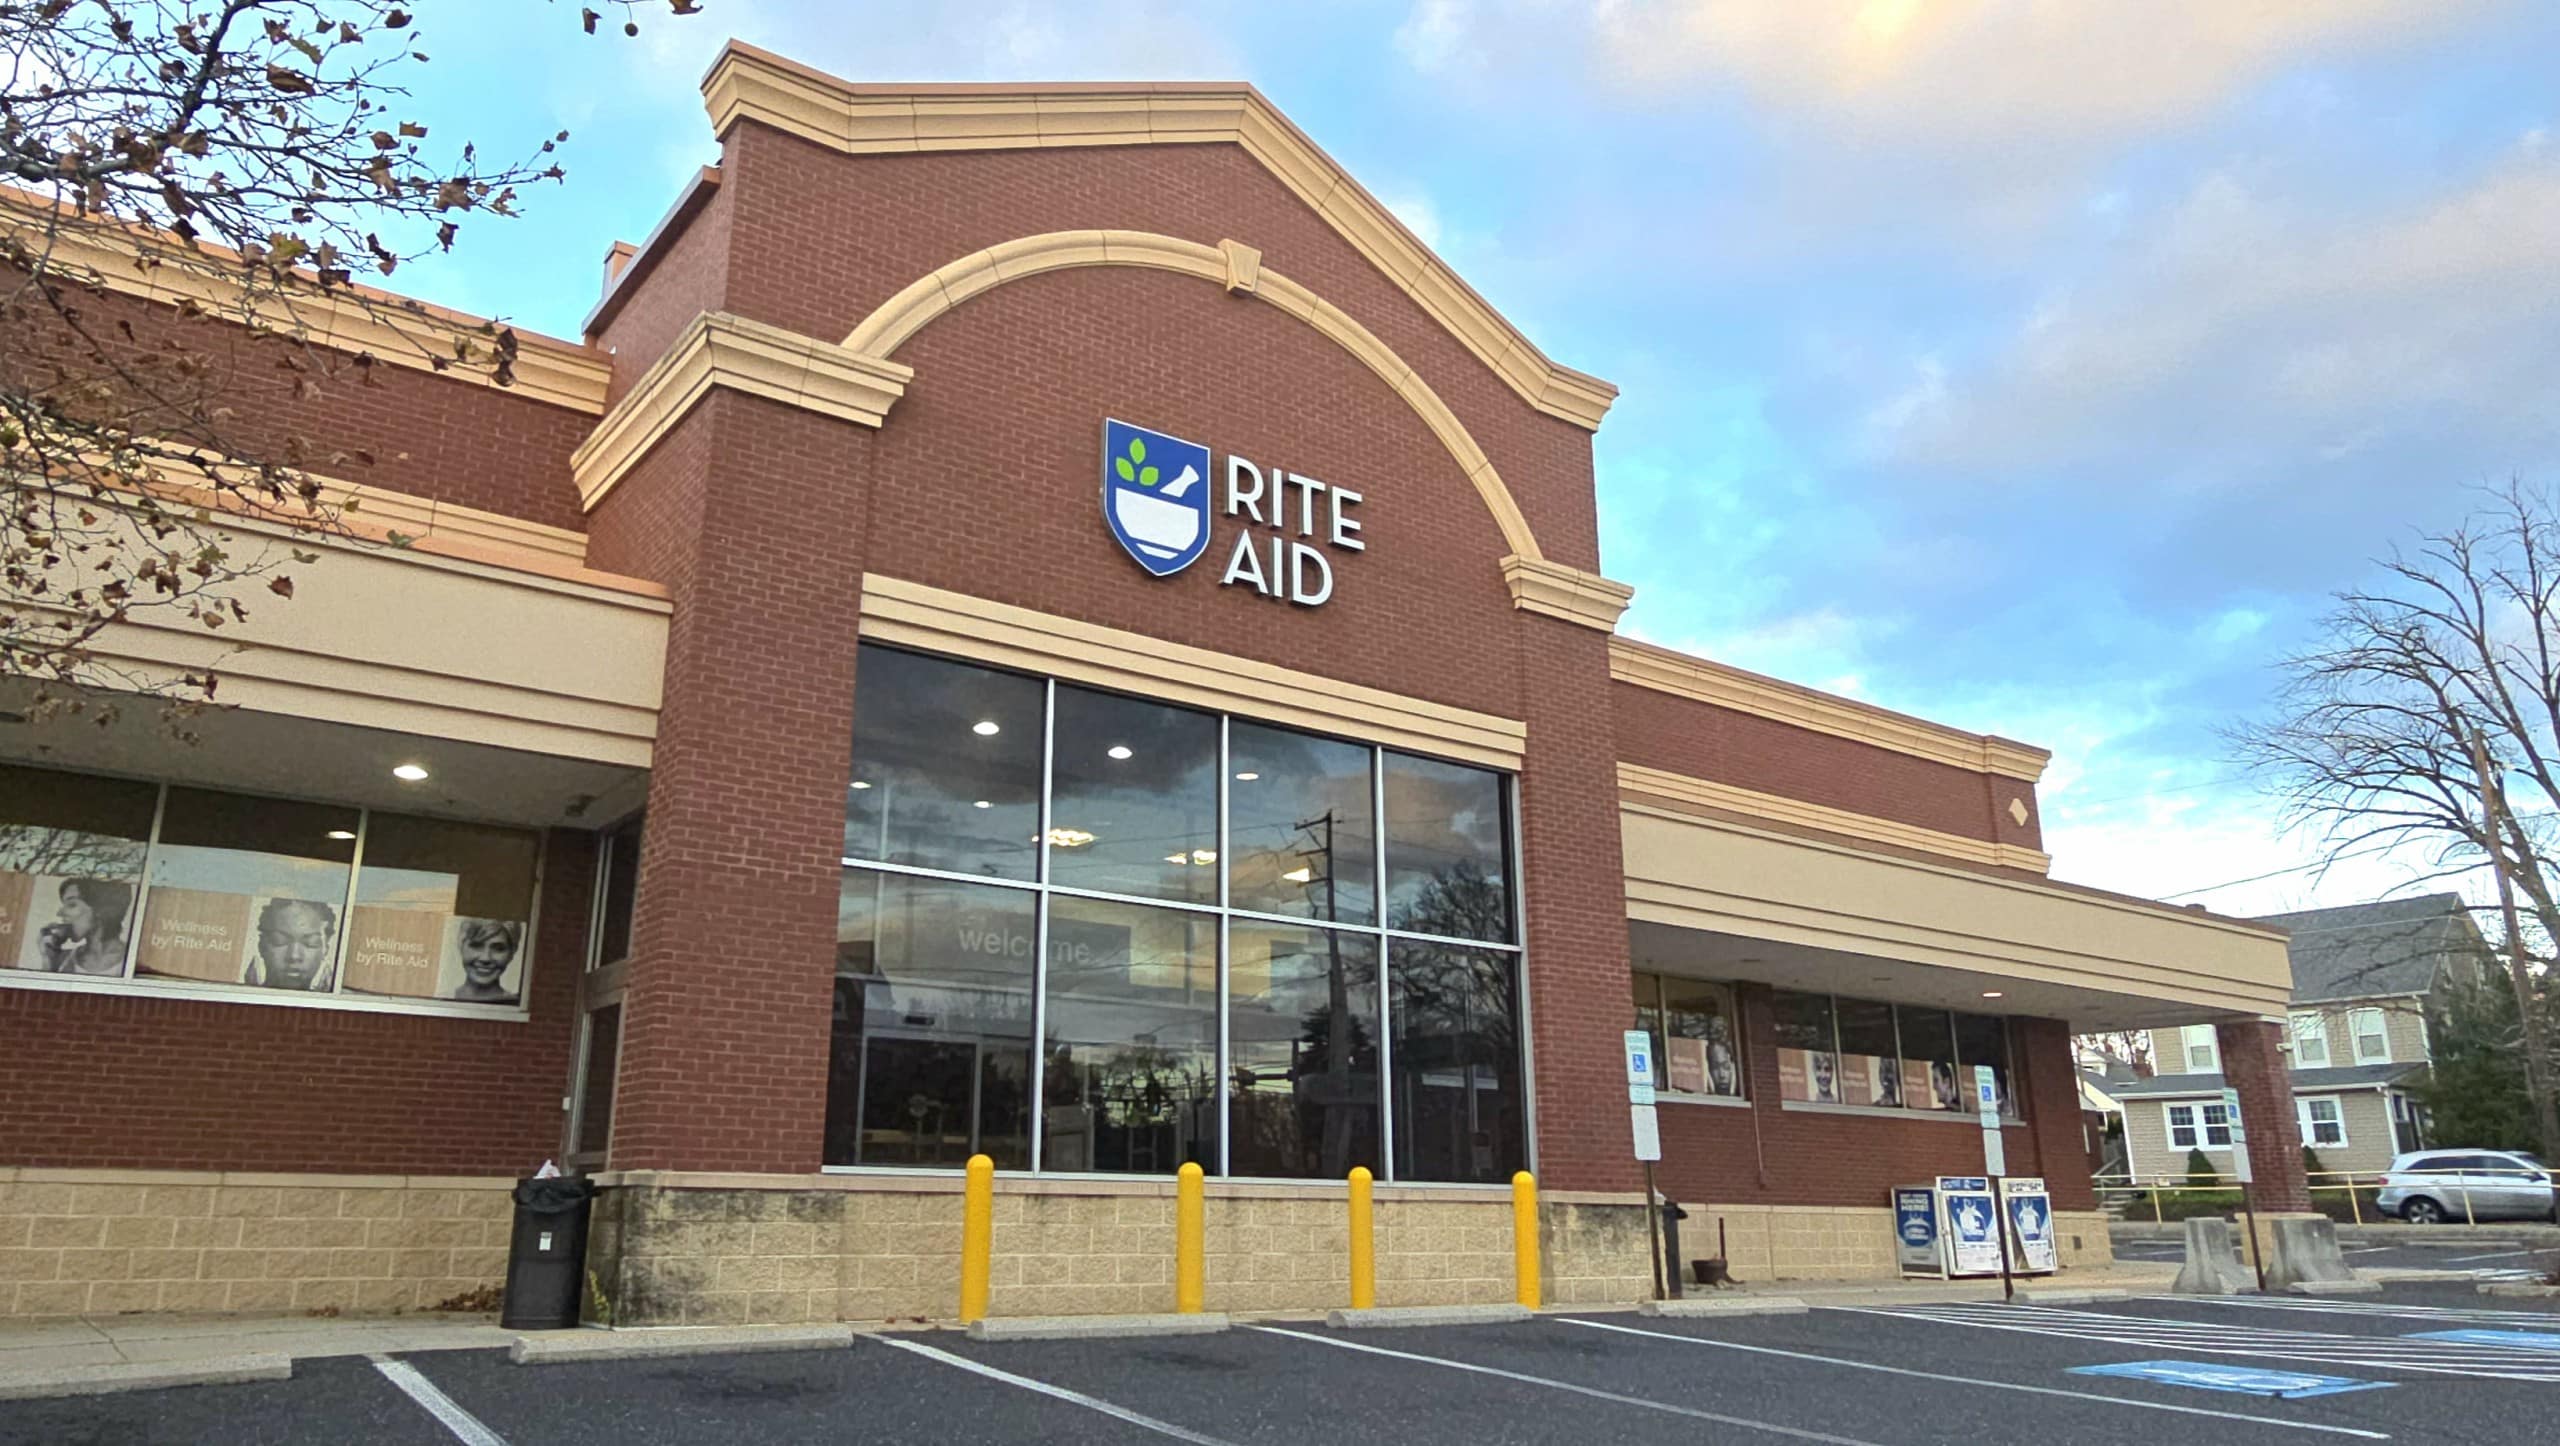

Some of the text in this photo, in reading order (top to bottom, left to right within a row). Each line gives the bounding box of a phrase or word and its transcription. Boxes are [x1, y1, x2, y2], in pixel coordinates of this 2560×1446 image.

[1225, 455, 1365, 551] RITE
[1220, 528, 1334, 606] AID
[161, 918, 226, 936] Wellness
[151, 932, 232, 952] by Rite Aid
[366, 936, 424, 953] Wellness
[959, 928, 1089, 963] welcme
[356, 951, 429, 969] by Rite Aid
